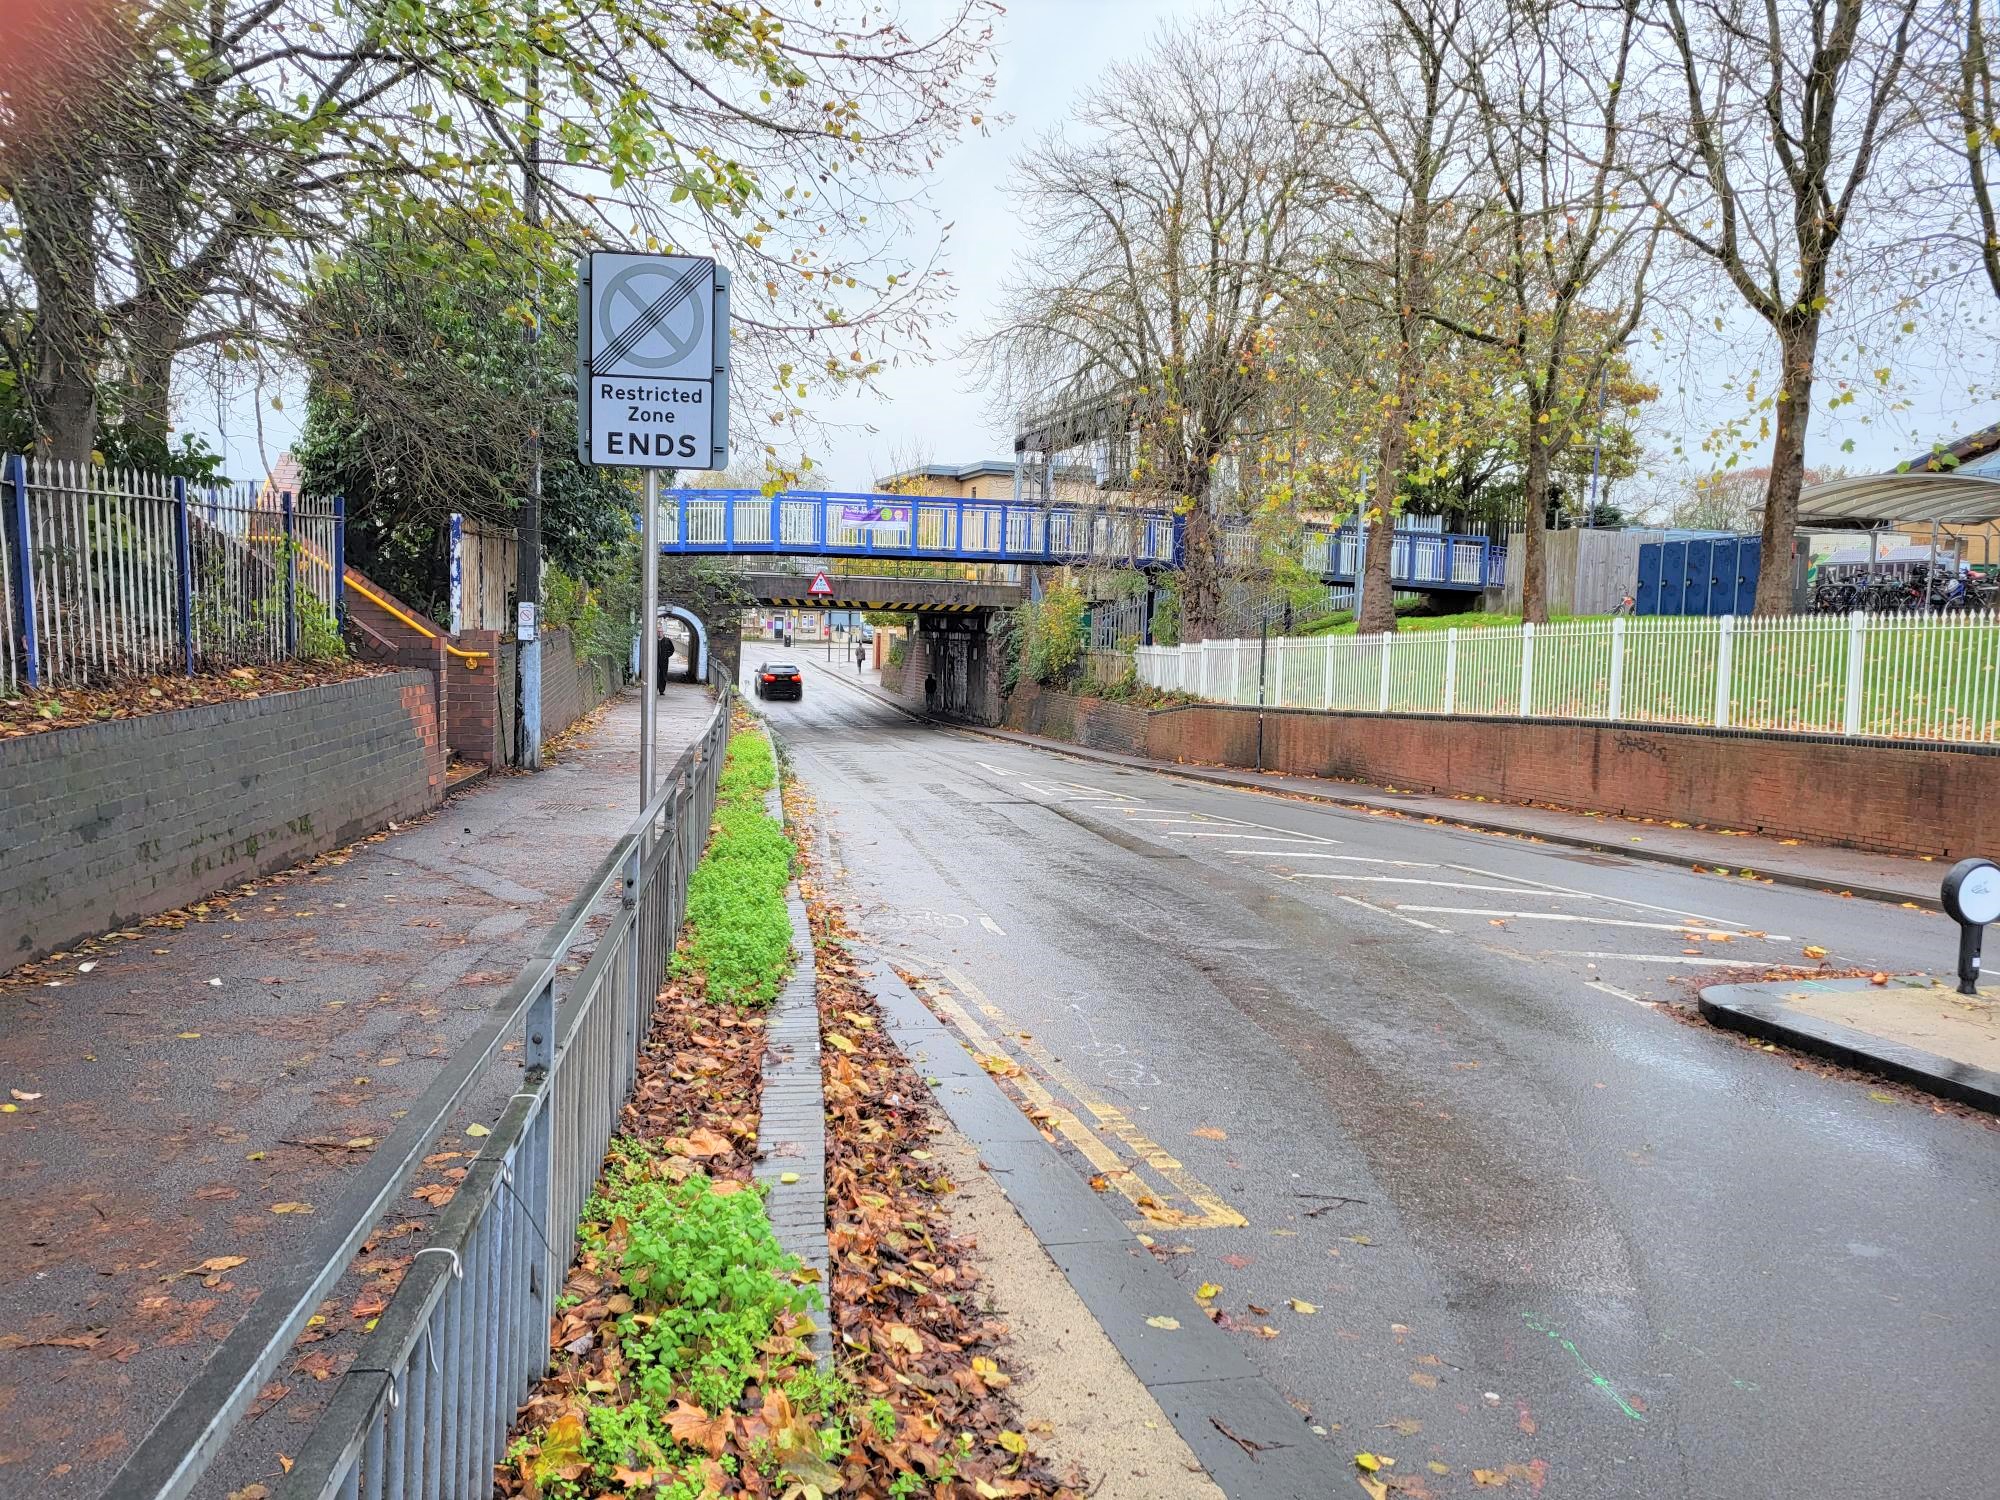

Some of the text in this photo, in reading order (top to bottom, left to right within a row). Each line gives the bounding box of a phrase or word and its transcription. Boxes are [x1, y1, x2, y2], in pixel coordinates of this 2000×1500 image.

[601, 384, 702, 403] Restricted
[628, 406, 675, 423] Zone
[608, 432, 696, 457] ENDS
